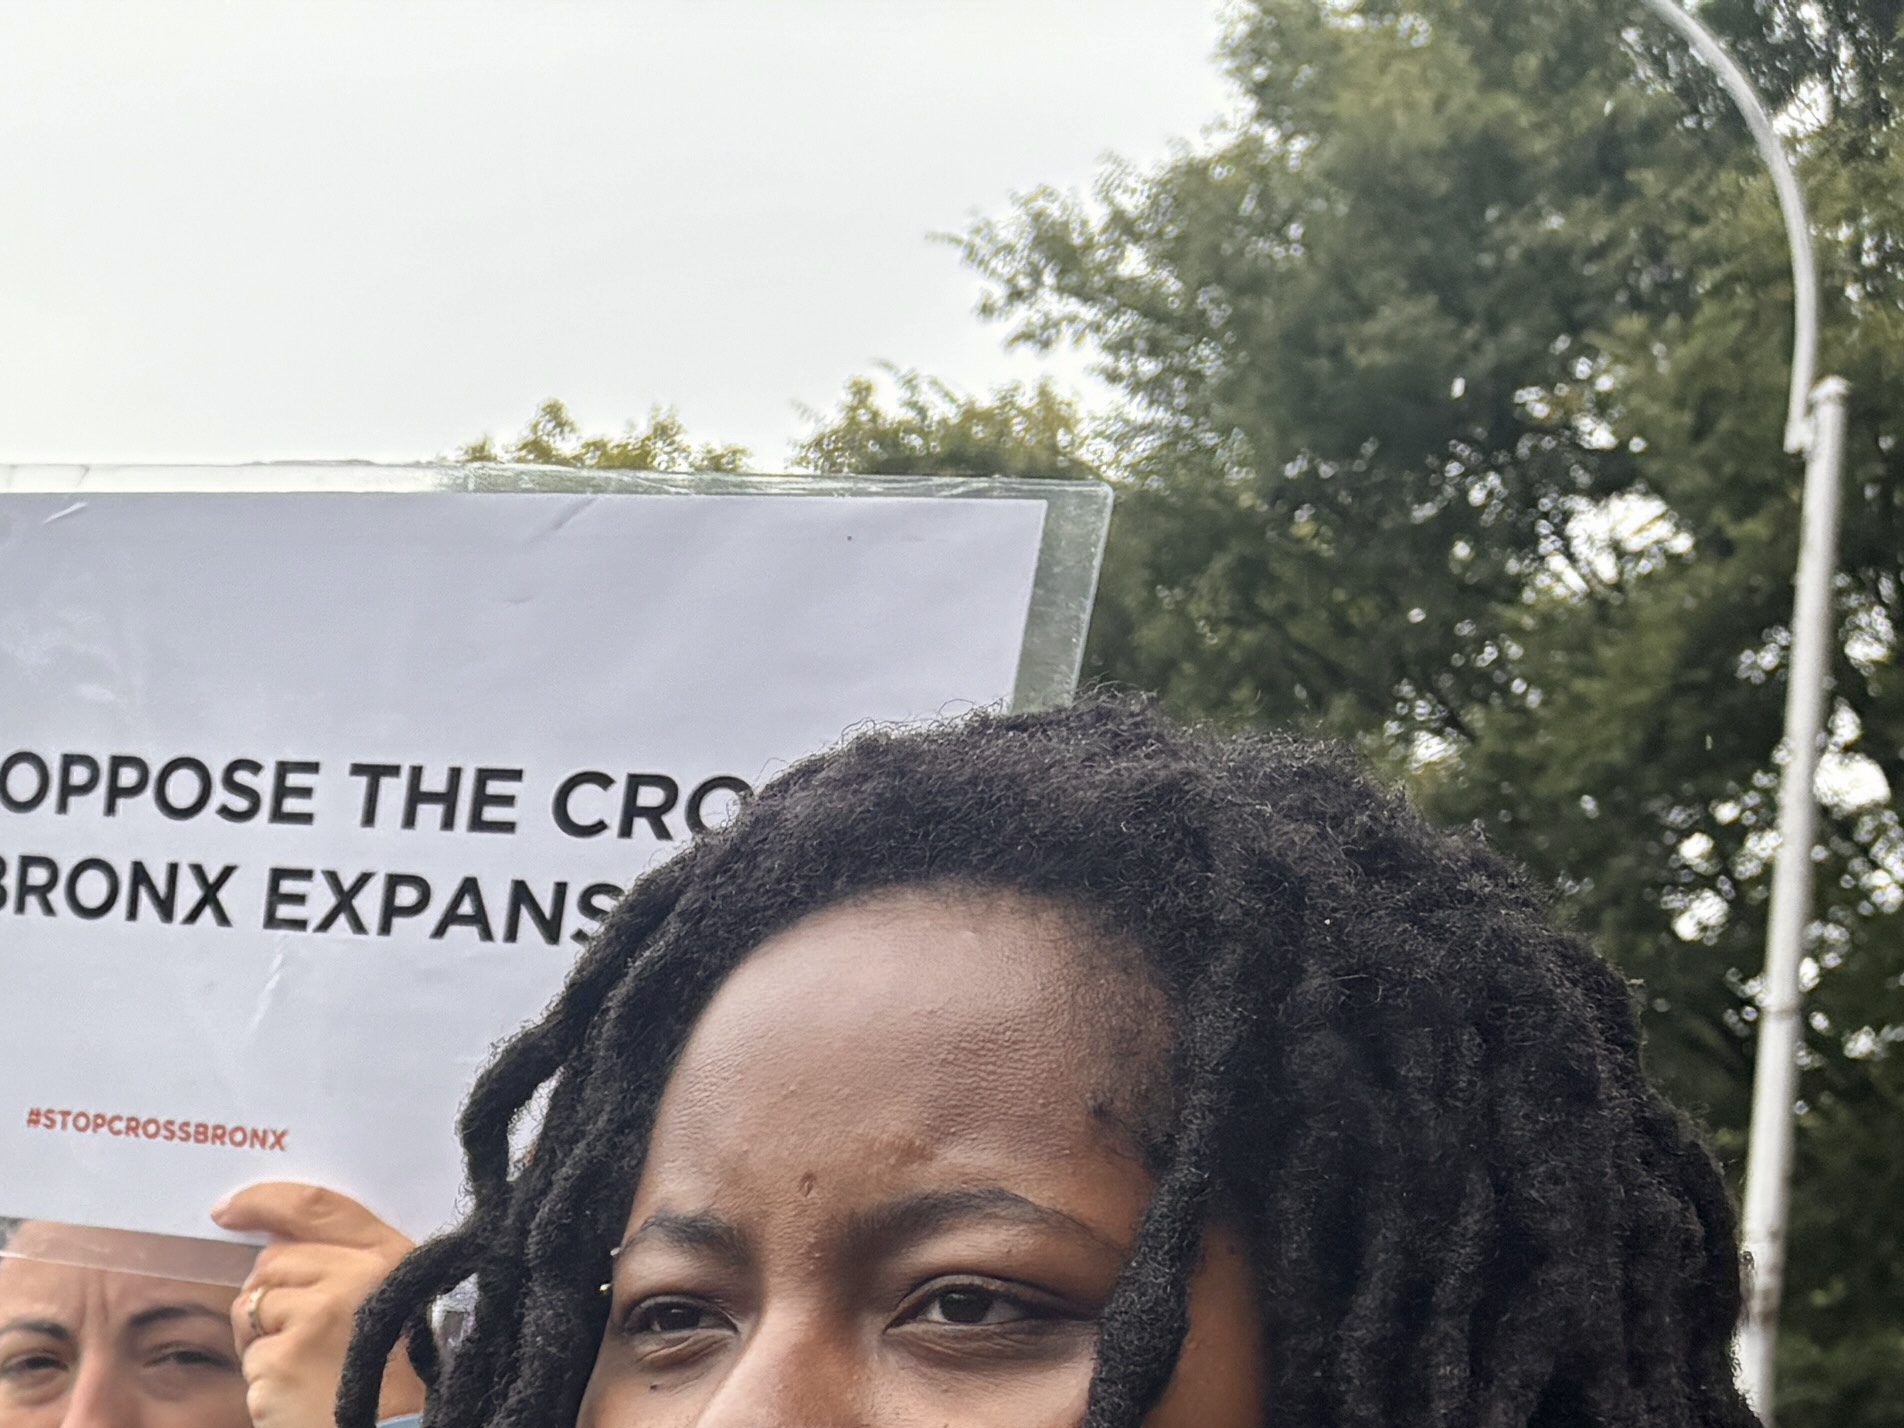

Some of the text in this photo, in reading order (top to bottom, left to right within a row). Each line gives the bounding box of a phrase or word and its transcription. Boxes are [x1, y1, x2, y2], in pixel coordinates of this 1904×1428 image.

[348, 761, 524, 834] THE
[551, 769, 756, 843] CRO
[261, 866, 626, 946] EXPANS
[26, 1106, 290, 1152] #STOPCROSSBRONX
